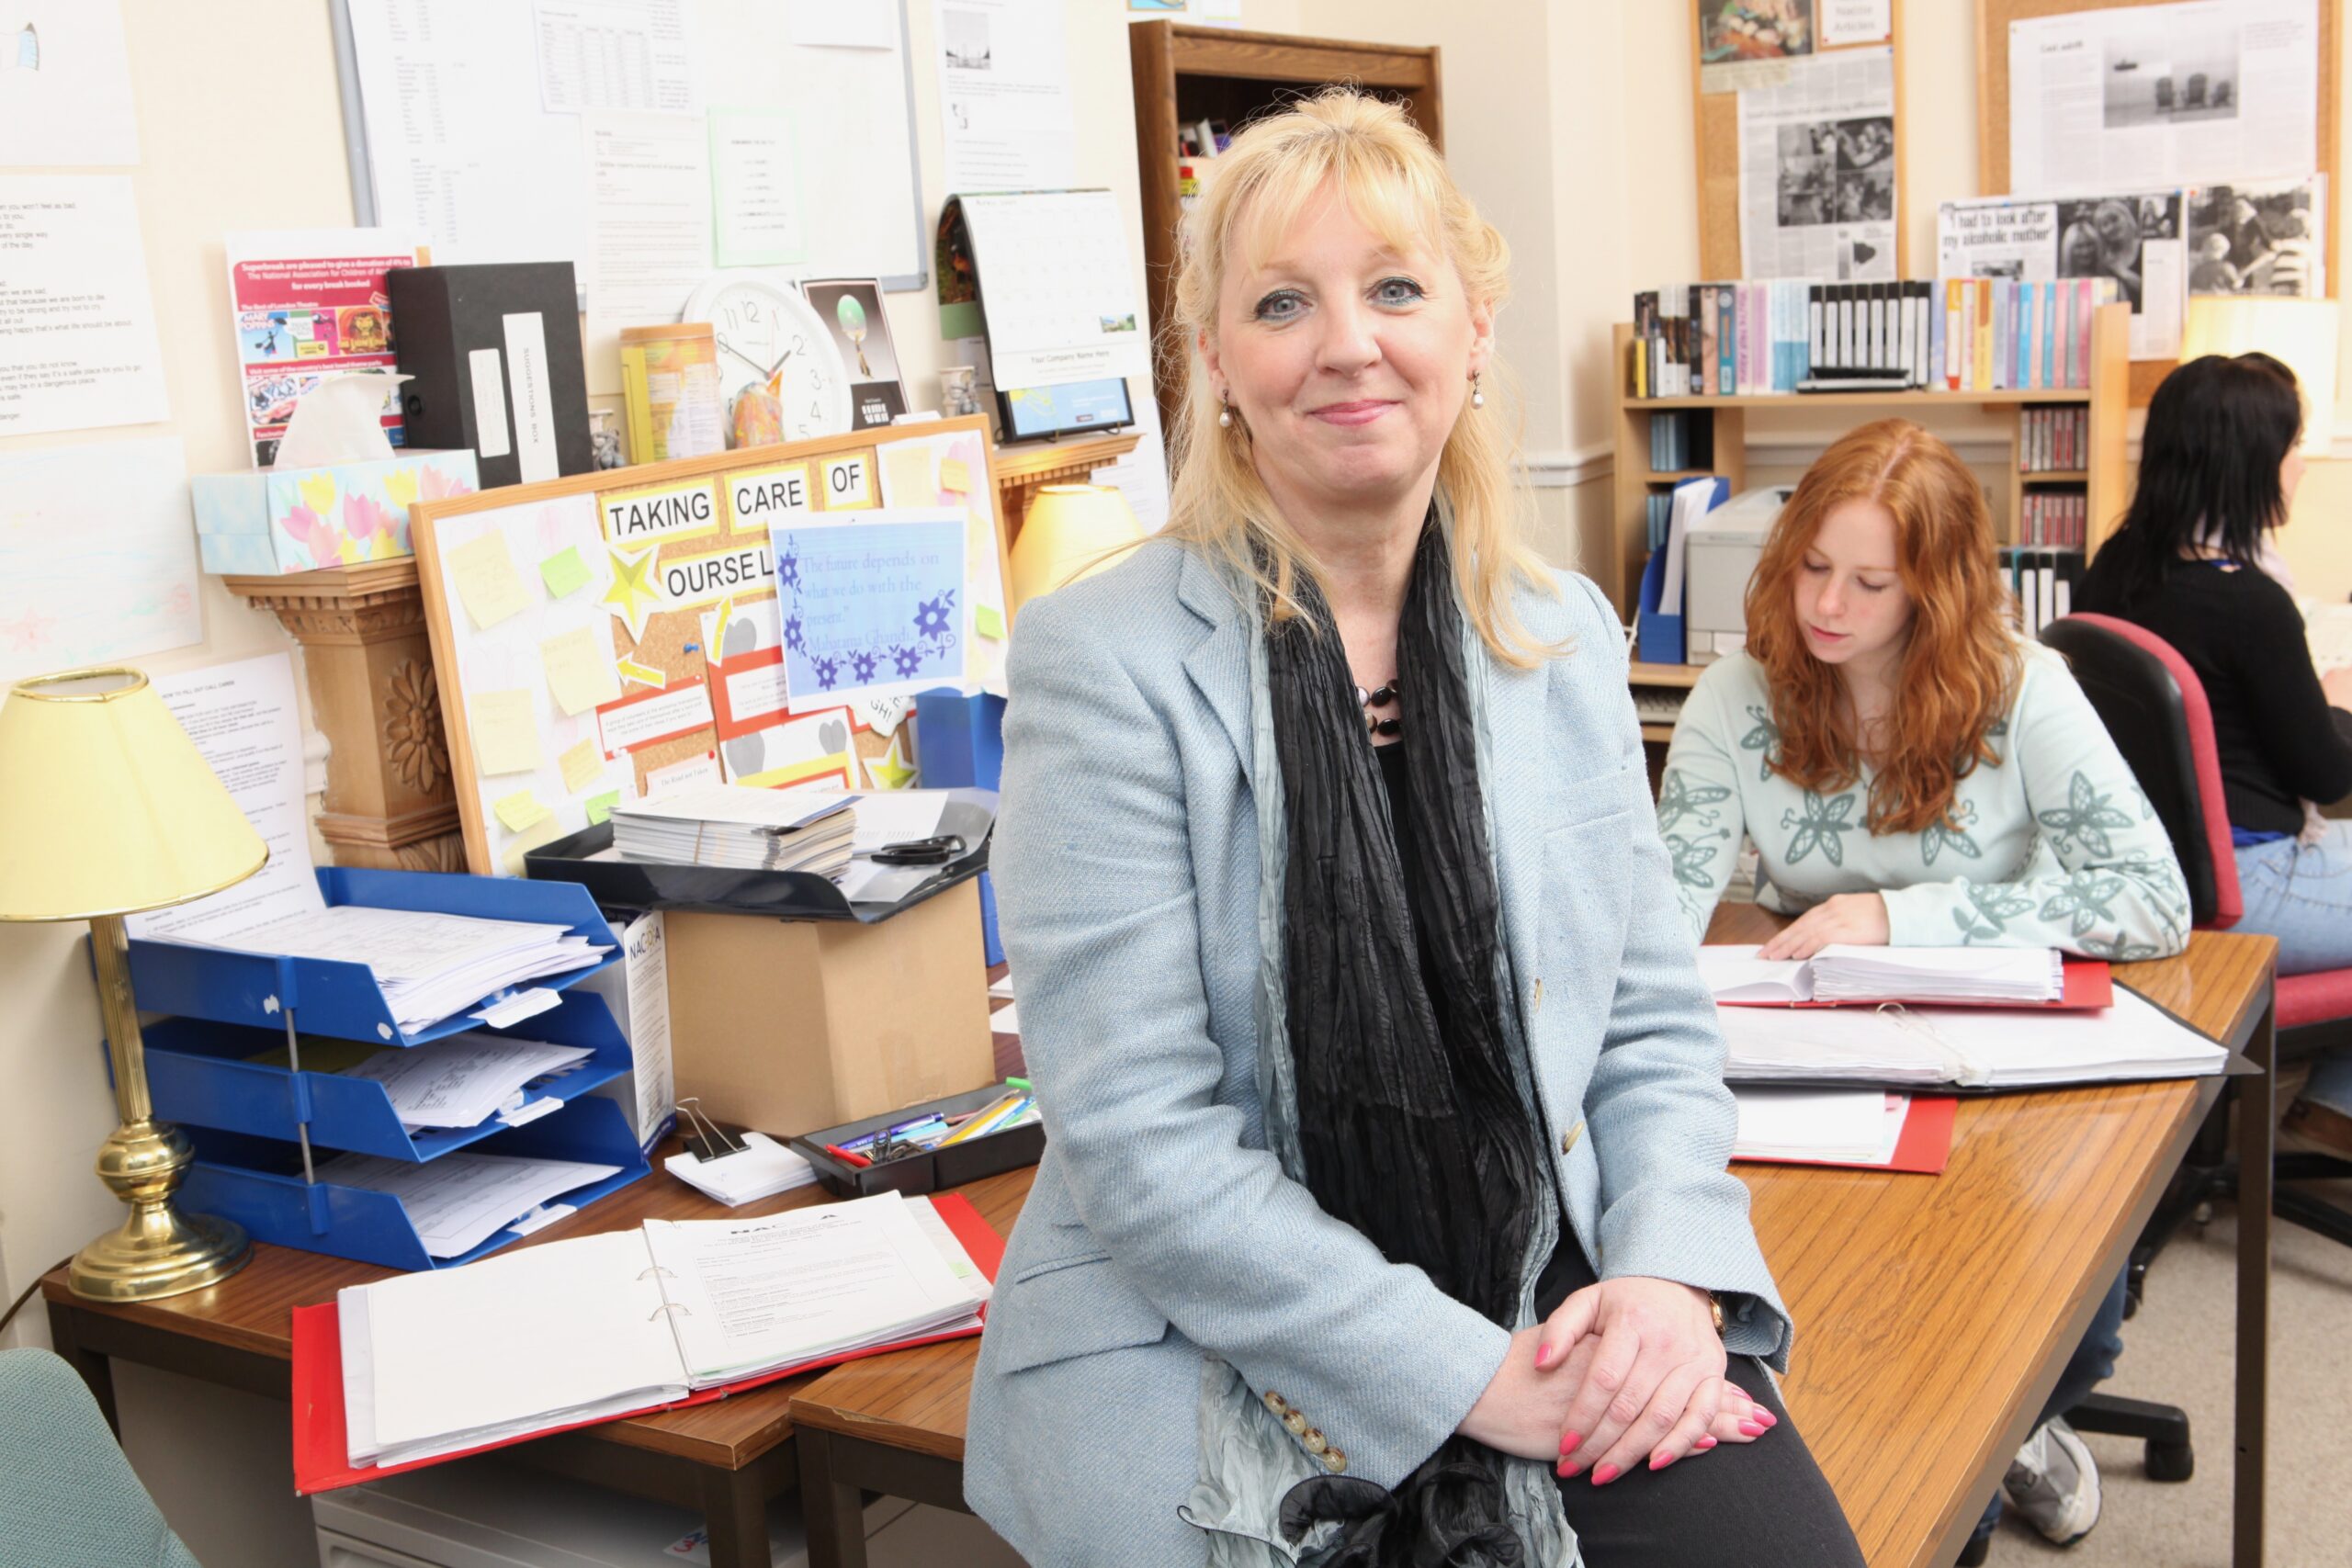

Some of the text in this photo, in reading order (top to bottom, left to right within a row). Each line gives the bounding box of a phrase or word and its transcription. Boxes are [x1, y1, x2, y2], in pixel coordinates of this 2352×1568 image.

[1959, 213, 1978, 228] had
[1981, 214, 1992, 226] to
[1996, 212, 2017, 225] look
[2021, 209, 2047, 224] after
[1962, 230, 2007, 246] alcoholic
[263, 270, 290, 279] National
[292, 269, 329, 278] Association
[341, 267, 367, 276] Children
[301, 260, 326, 271] pleased
[304, 282, 323, 291] every
[324, 280, 345, 289] break
[724, 308, 740, 331] 11
[742, 301, 760, 323] 12
[793, 334, 807, 355] 2
[1047, 354, 1075, 363] Company
[810, 369, 823, 390] 3
[523, 346, 539, 445] SUGGESTIONS BOX
[810, 401, 822, 422] 4
[609, 464, 860, 536] TAKING CARE OF
[826, 555, 859, 571] future
[862, 550, 916, 573] depends
[921, 554, 940, 565] on
[667, 549, 774, 598] OURSEL
[805, 575, 922, 599] what we do with the
[629, 922, 662, 962] NACOA
